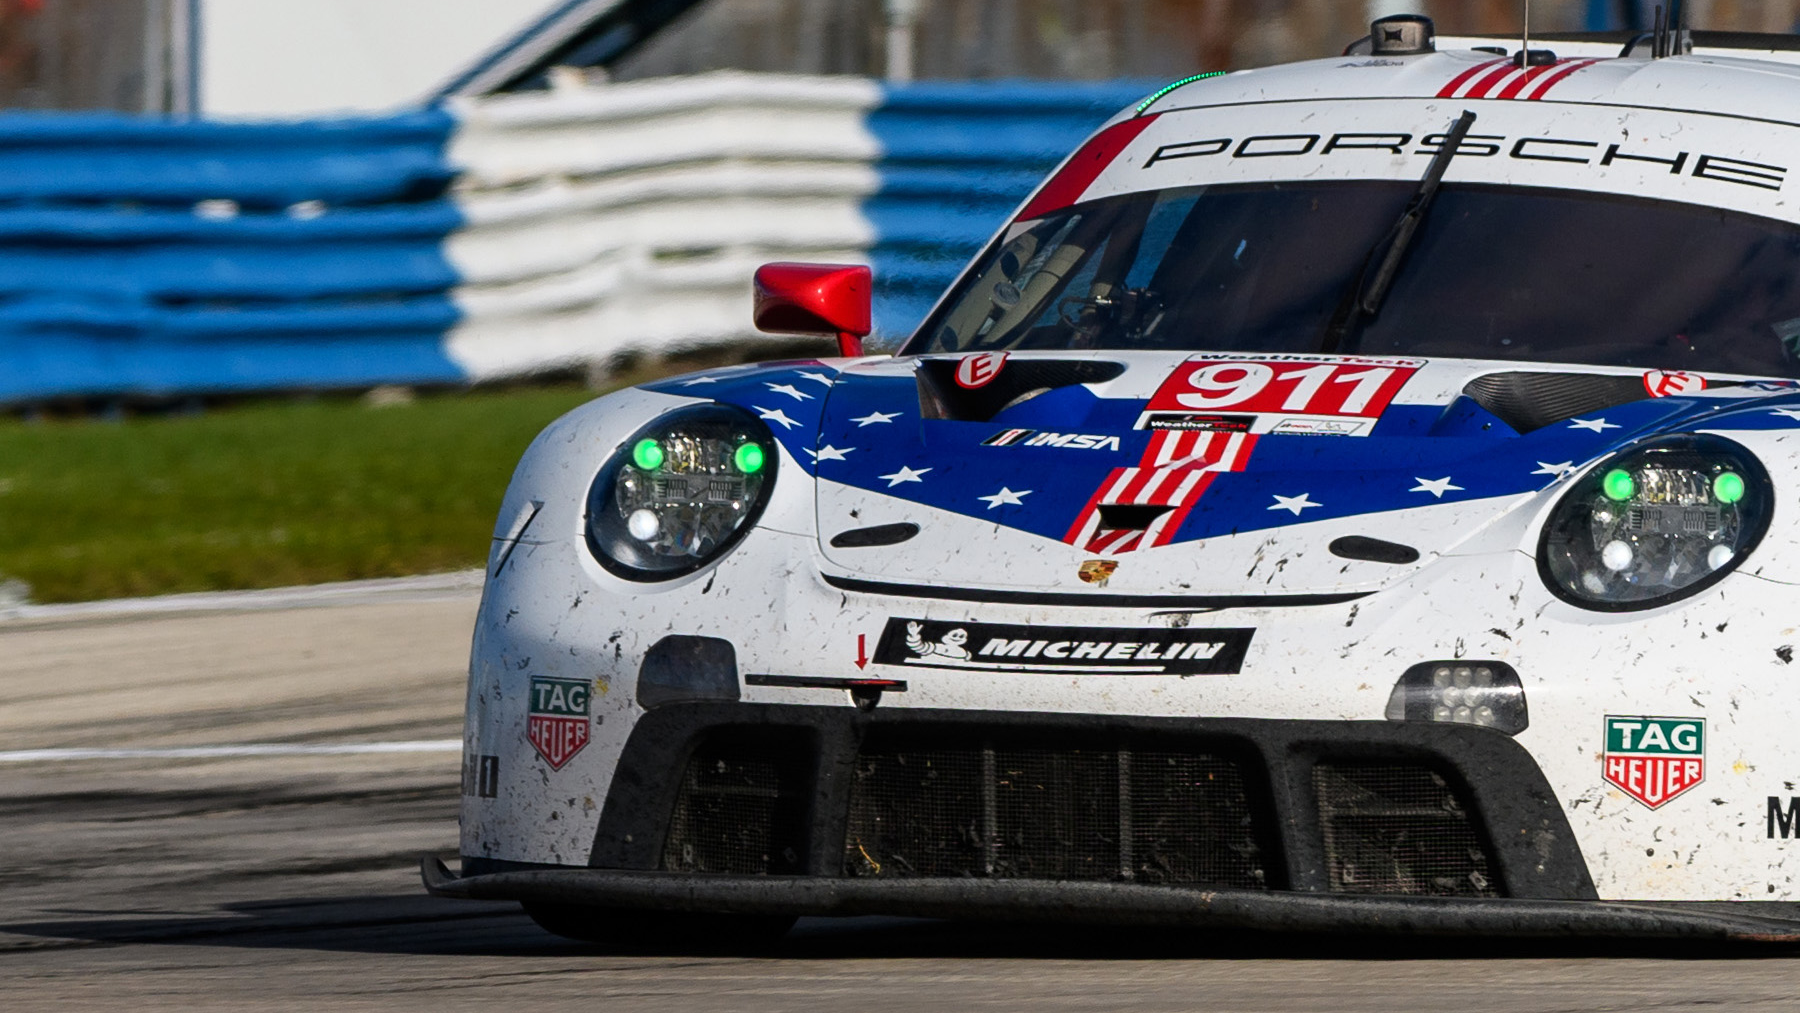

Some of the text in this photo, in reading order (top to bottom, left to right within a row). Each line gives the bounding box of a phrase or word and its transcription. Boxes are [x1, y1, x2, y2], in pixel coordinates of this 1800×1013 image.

[1142, 133, 1788, 192] PORSCHE
[1200, 353, 1415, 366] WeatherTech
[1176, 363, 1397, 414] 911
[1023, 432, 1121, 452] IMSA
[978, 638, 1226, 660] MICHELIN
[534, 683, 585, 713] TAG
[530, 719, 587, 764] HEUER
[1612, 722, 1697, 752] TAG
[1609, 758, 1700, 804] HEUER
